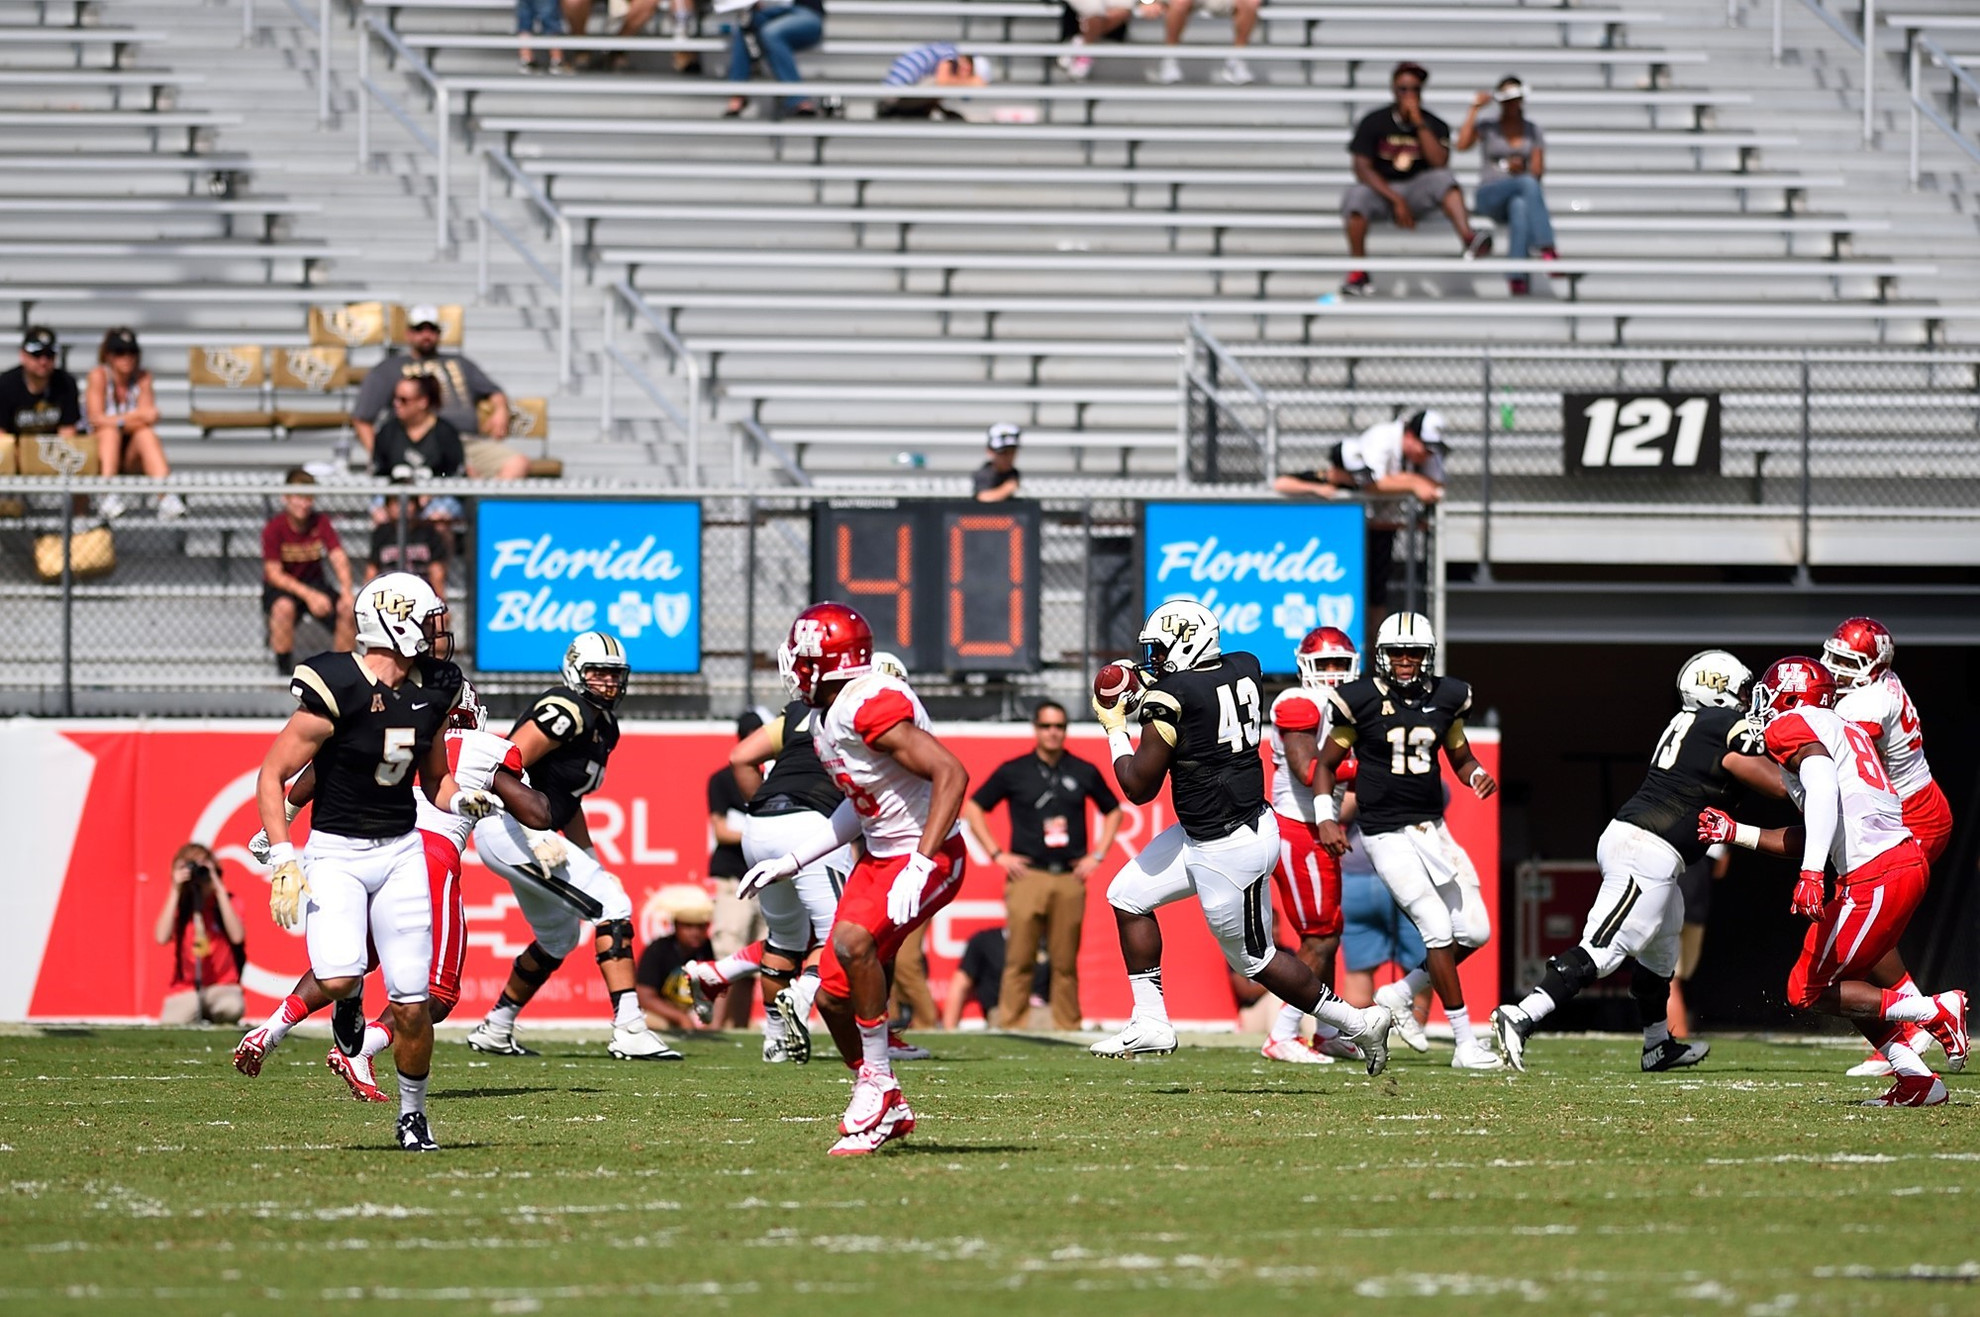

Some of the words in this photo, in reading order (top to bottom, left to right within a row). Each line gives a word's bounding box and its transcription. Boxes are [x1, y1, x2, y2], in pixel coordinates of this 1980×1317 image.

[1581, 397, 1709, 467] 121
[489, 533, 683, 582] Florida
[1157, 535, 1346, 583] Florida
[372, 588, 416, 622] UCF
[487, 585, 598, 632] Blue
[837, 515, 1024, 657] 40
[1695, 670, 1730, 694] UCF
[537, 704, 572, 736] 78
[1215, 675, 1261, 754] 43
[374, 727, 416, 787] 5
[1386, 725, 1437, 775] 13
[1641, 1044, 1666, 1070] NIKE
